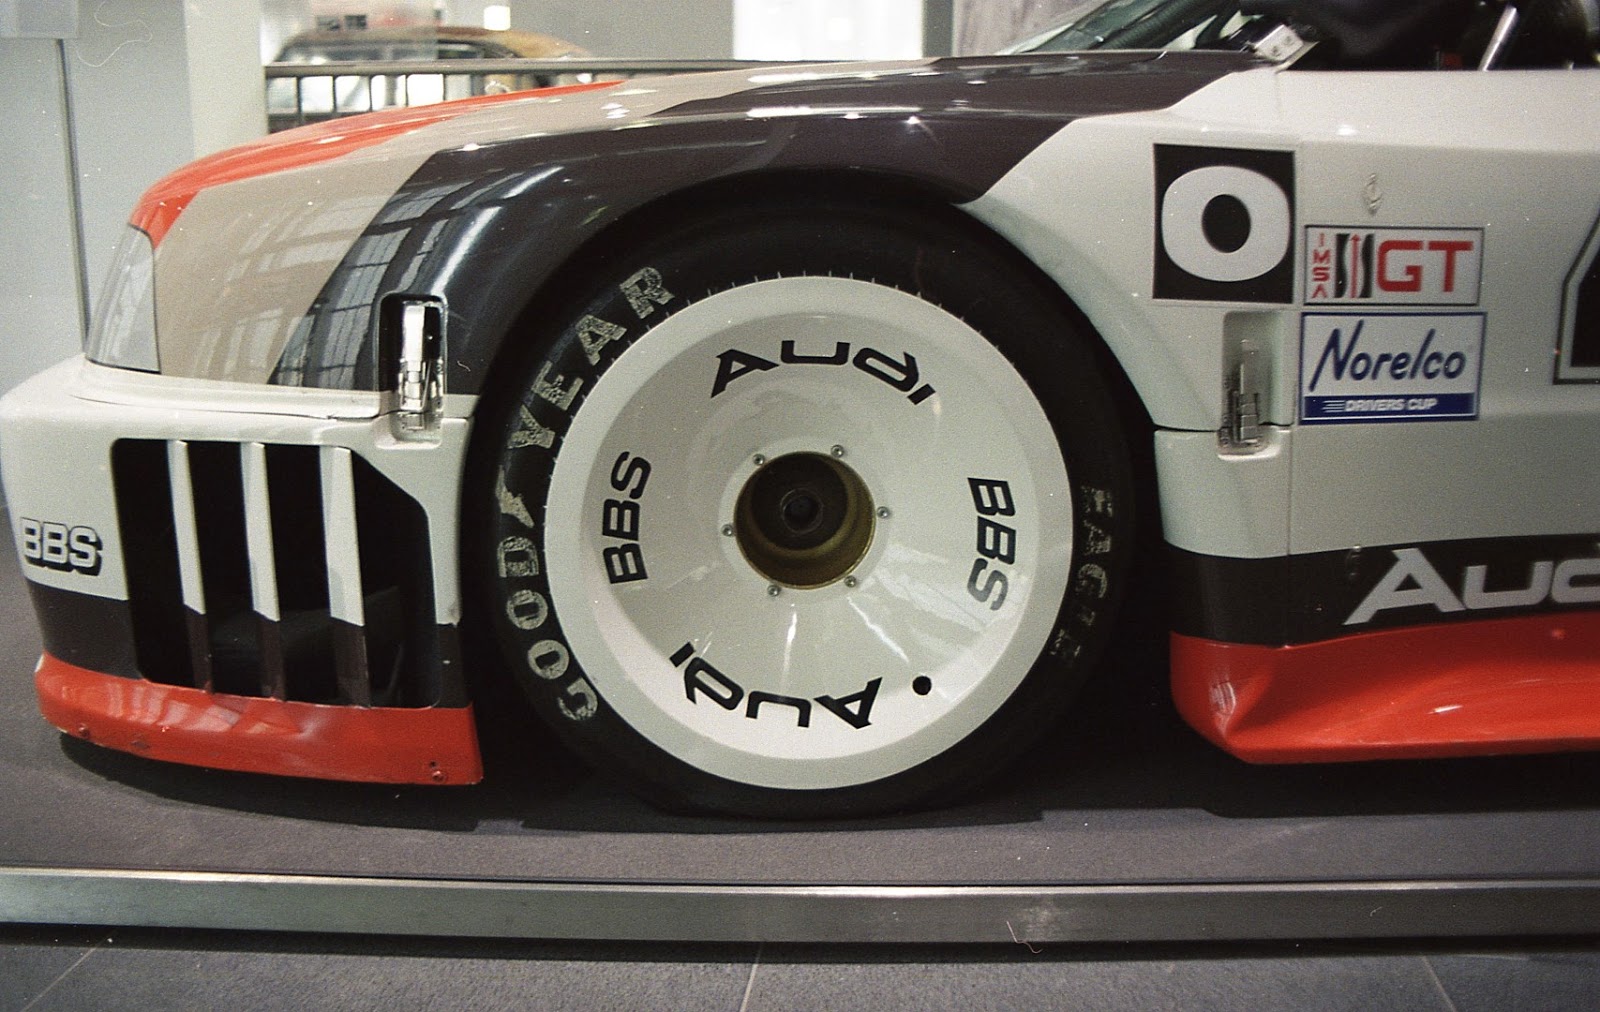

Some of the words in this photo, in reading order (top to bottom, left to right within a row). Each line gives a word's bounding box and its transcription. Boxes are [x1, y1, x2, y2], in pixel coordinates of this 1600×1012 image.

[1312, 233, 1332, 299] IMSA
[1377, 240, 1474, 292] GT
[1309, 319, 1466, 392] Norelco
[1344, 399, 1405, 412] DRIVERS
[1407, 398, 1438, 411] CUP
[20, 517, 103, 577] BBS
[603, 451, 652, 584] BBS
[967, 477, 1016, 611] BBS
